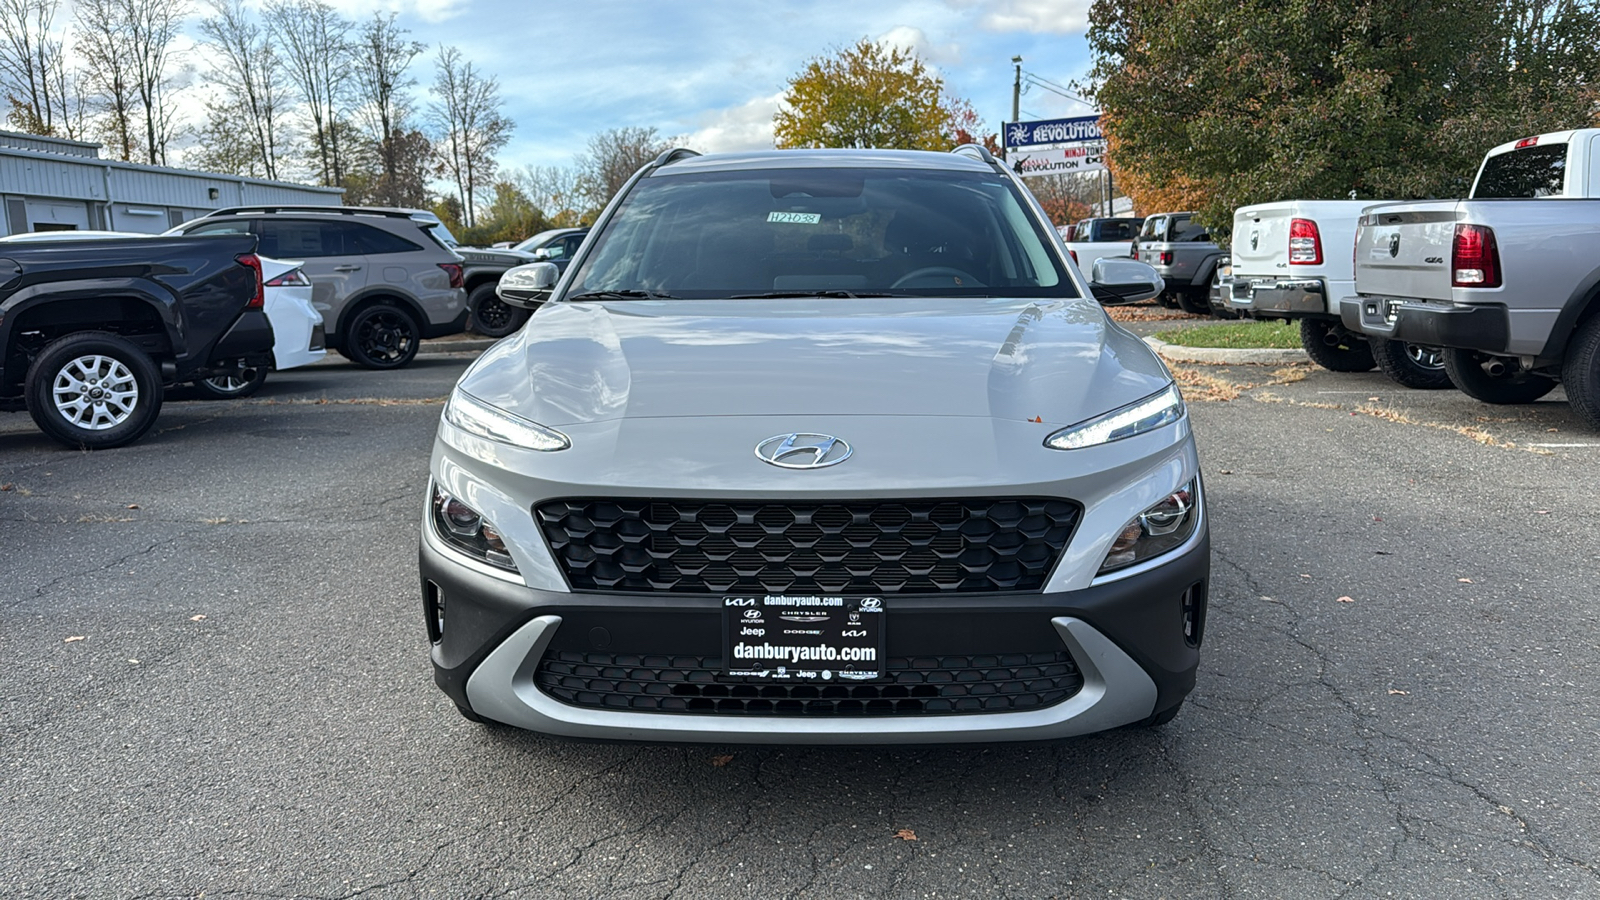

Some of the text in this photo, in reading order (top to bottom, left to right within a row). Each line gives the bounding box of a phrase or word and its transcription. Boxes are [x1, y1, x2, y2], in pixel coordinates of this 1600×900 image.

[1022, 161, 1079, 173] REVOLUTION
[764, 595, 843, 607] danburyauto.com
[740, 626, 766, 637] Jeep
[733, 642, 876, 663] danburyauto.com
[796, 669, 817, 679] Jeep
